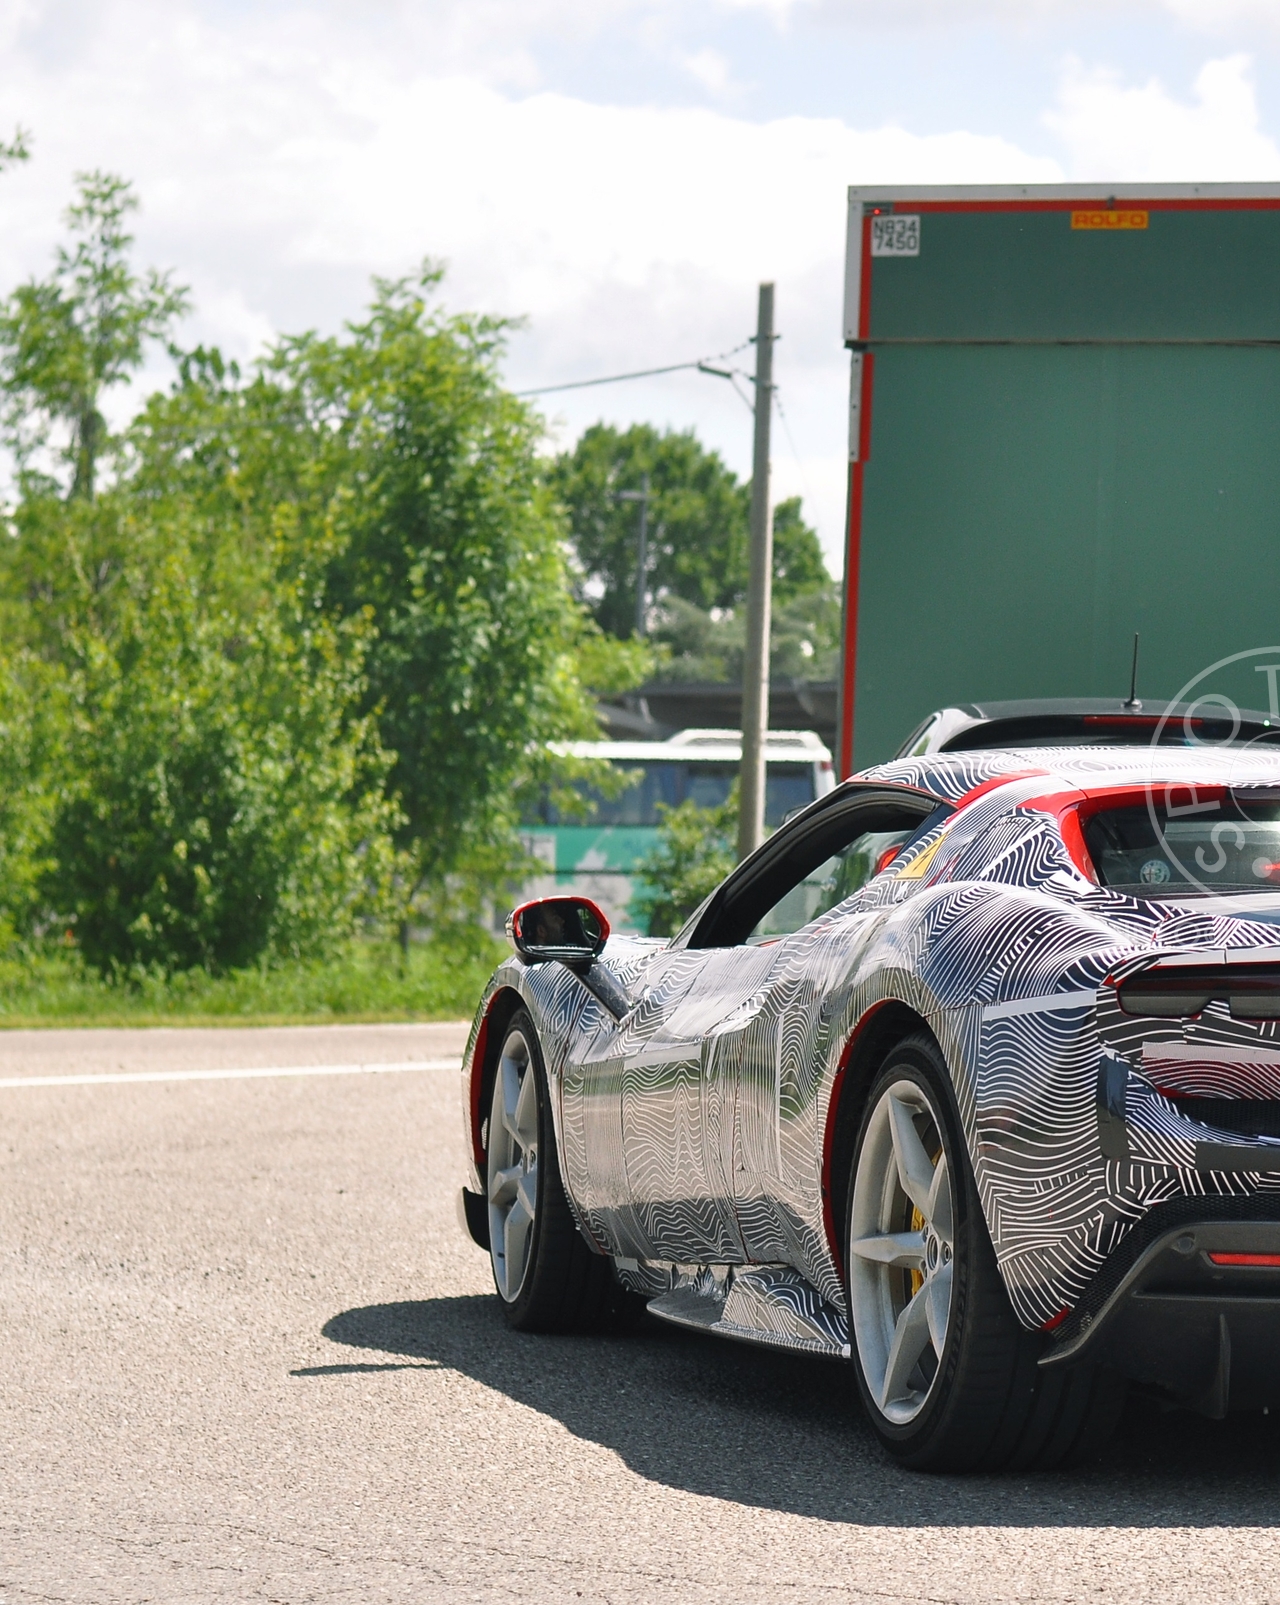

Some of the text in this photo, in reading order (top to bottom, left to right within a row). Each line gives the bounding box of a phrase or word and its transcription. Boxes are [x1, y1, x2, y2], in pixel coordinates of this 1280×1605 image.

[1075, 213, 1145, 227] ROLFO
[874, 235, 918, 250] 7450
[945, 1261, 968, 1382] MICHELIN
